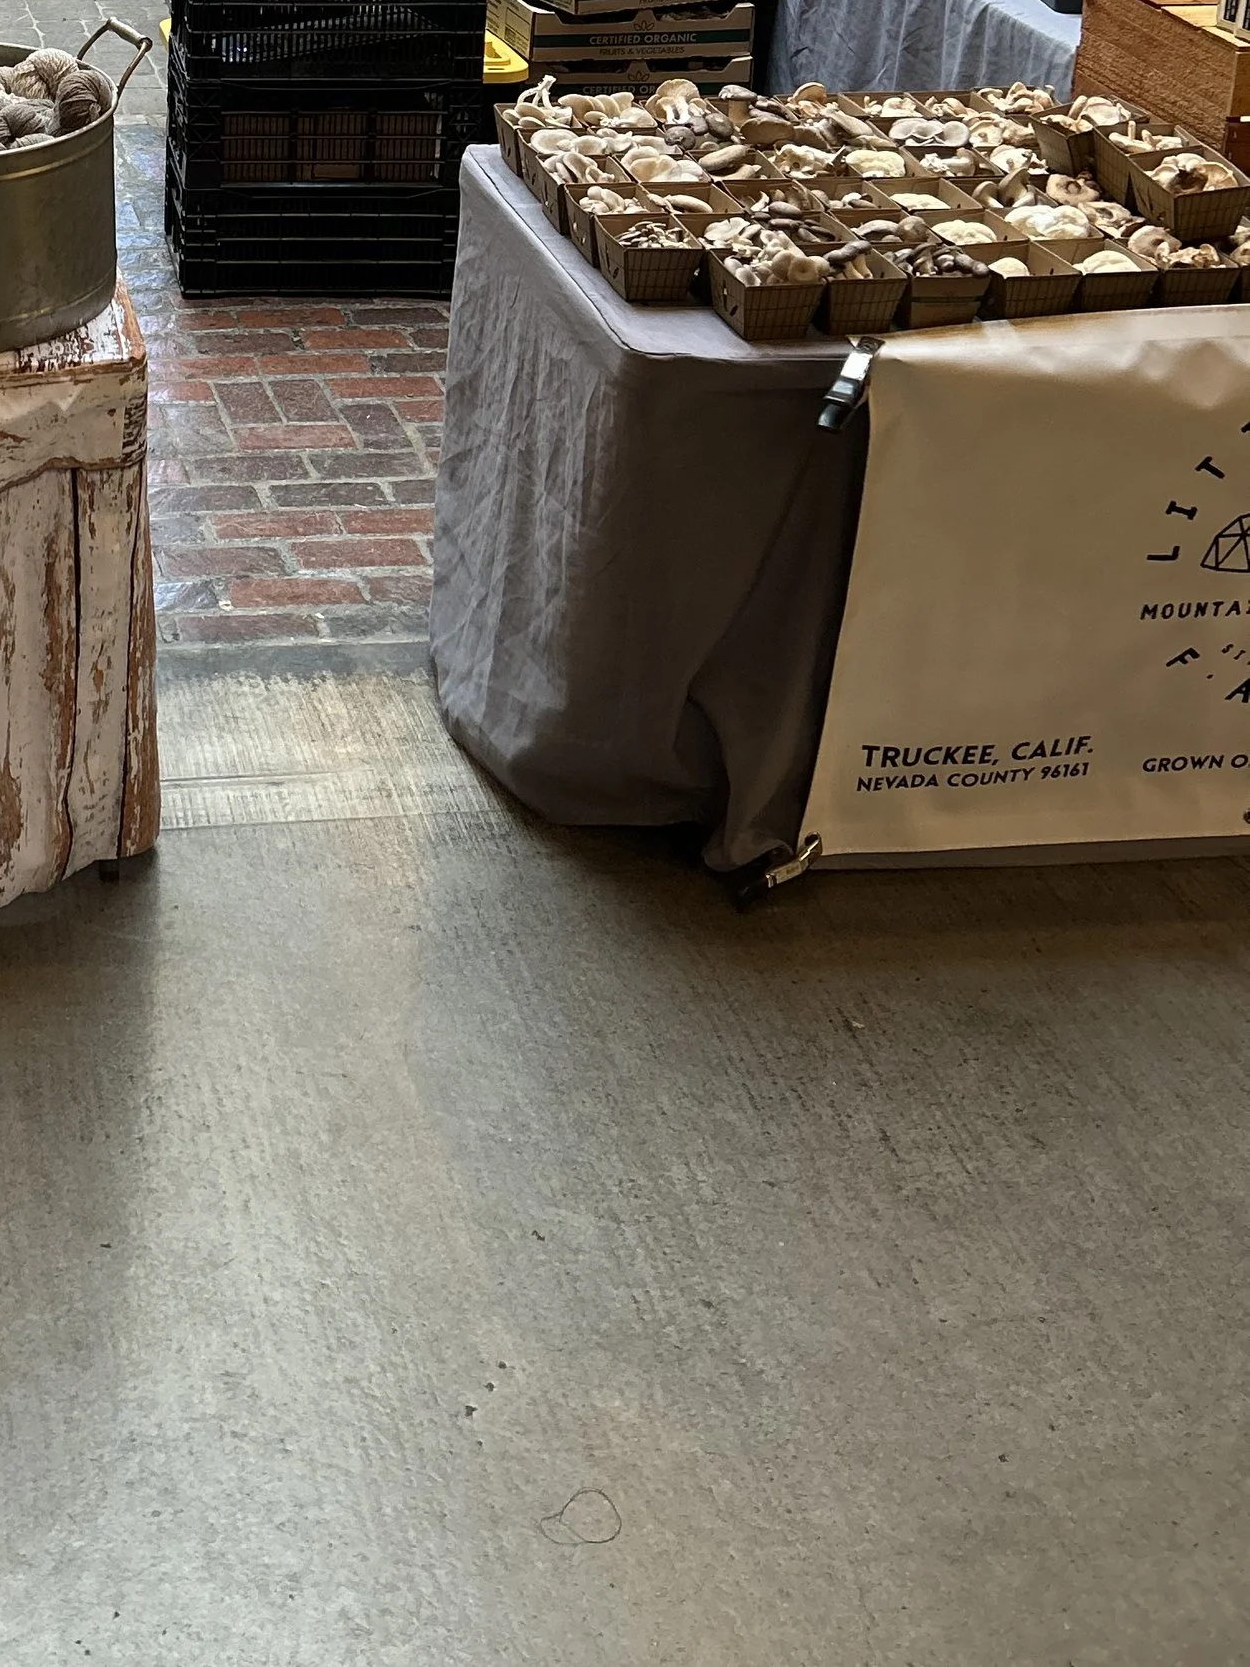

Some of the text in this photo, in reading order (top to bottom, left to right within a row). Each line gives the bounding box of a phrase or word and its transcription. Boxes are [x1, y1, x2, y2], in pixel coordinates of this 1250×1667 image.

[589, 33, 697, 45] CERTIFIED ORGANIC
[599, 46, 686, 56] FRUITS & VEGETABLES
[582, 85, 636, 95] CERTIFIED
[861, 735, 1095, 769] TRUCKEE, CALIF.
[1142, 753, 1224, 774] GROWN
[857, 761, 1090, 793] NEVADA COUNTY 96161
